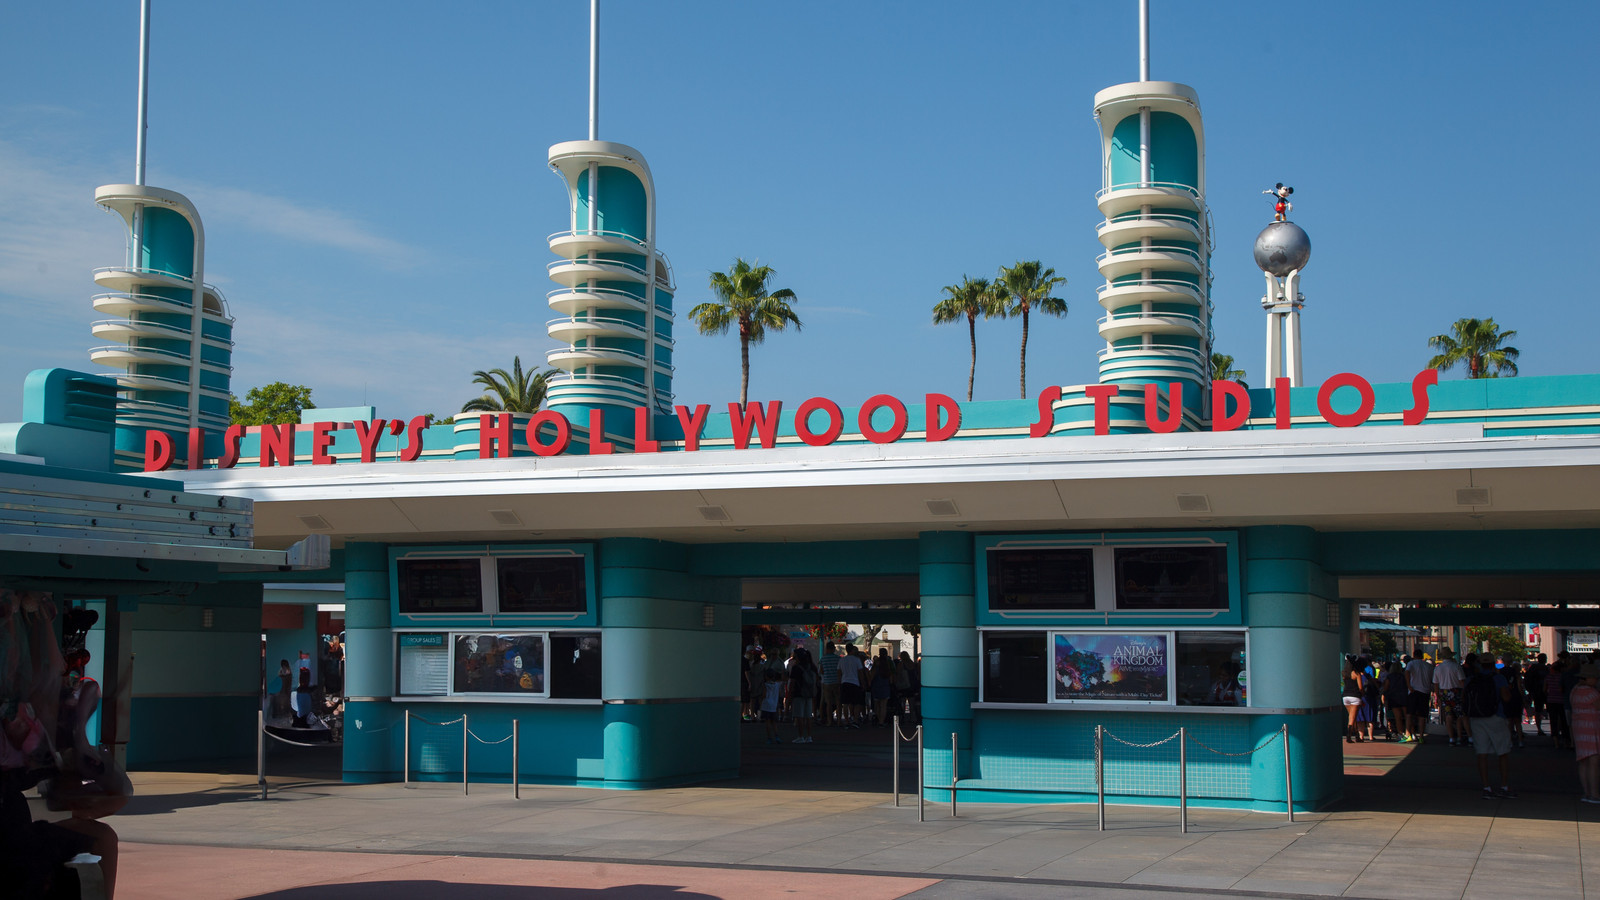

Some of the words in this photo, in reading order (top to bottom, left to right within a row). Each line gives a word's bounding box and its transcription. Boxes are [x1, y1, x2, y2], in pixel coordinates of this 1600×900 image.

[144, 415, 430, 473] DISNEY'S
[479, 394, 961, 459] HOLLYWOOD
[1030, 368, 1438, 438] STUDIOS
[1113, 645, 1164, 656] ANIMAL
[1113, 655, 1164, 666] KINGDOM
